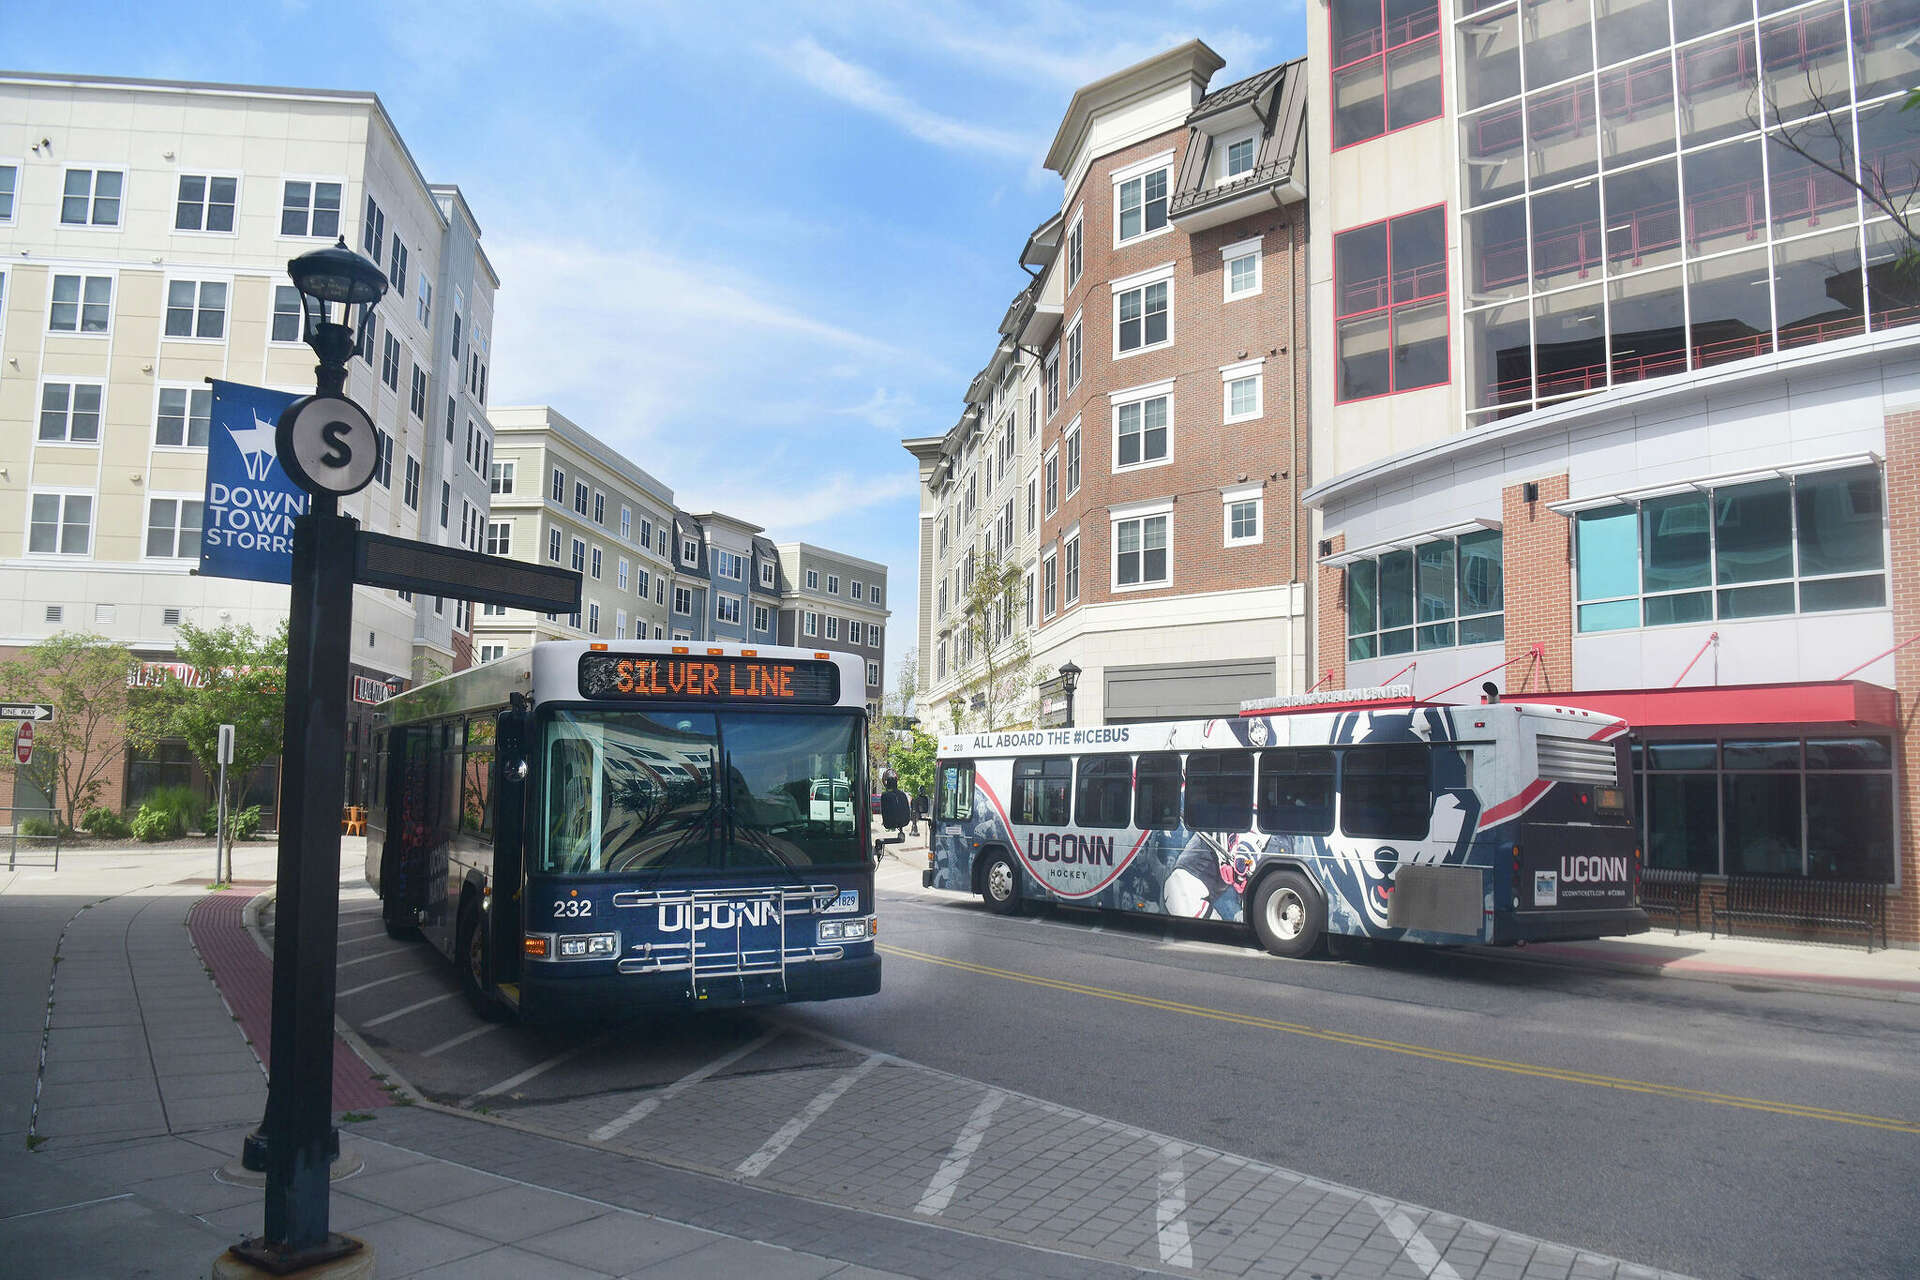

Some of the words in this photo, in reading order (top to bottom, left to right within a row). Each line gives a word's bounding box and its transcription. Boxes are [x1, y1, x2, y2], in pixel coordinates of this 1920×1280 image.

[321, 421, 353, 469] S
[210, 482, 305, 516] DOWN
[616, 660, 719, 696] SILVER
[729, 664, 795, 697] LINE
[973, 736, 993, 750] ALL
[995, 733, 1044, 748] ABOARD
[1047, 731, 1071, 745] THE
[1073, 727, 1130, 744] #ICEBUS
[1028, 832, 1114, 867] UCONN
[1050, 869, 1087, 879] HOCKEY
[1561, 855, 1628, 882] UCONN
[553, 899, 592, 918] 232
[658, 901, 781, 932] UCONN
